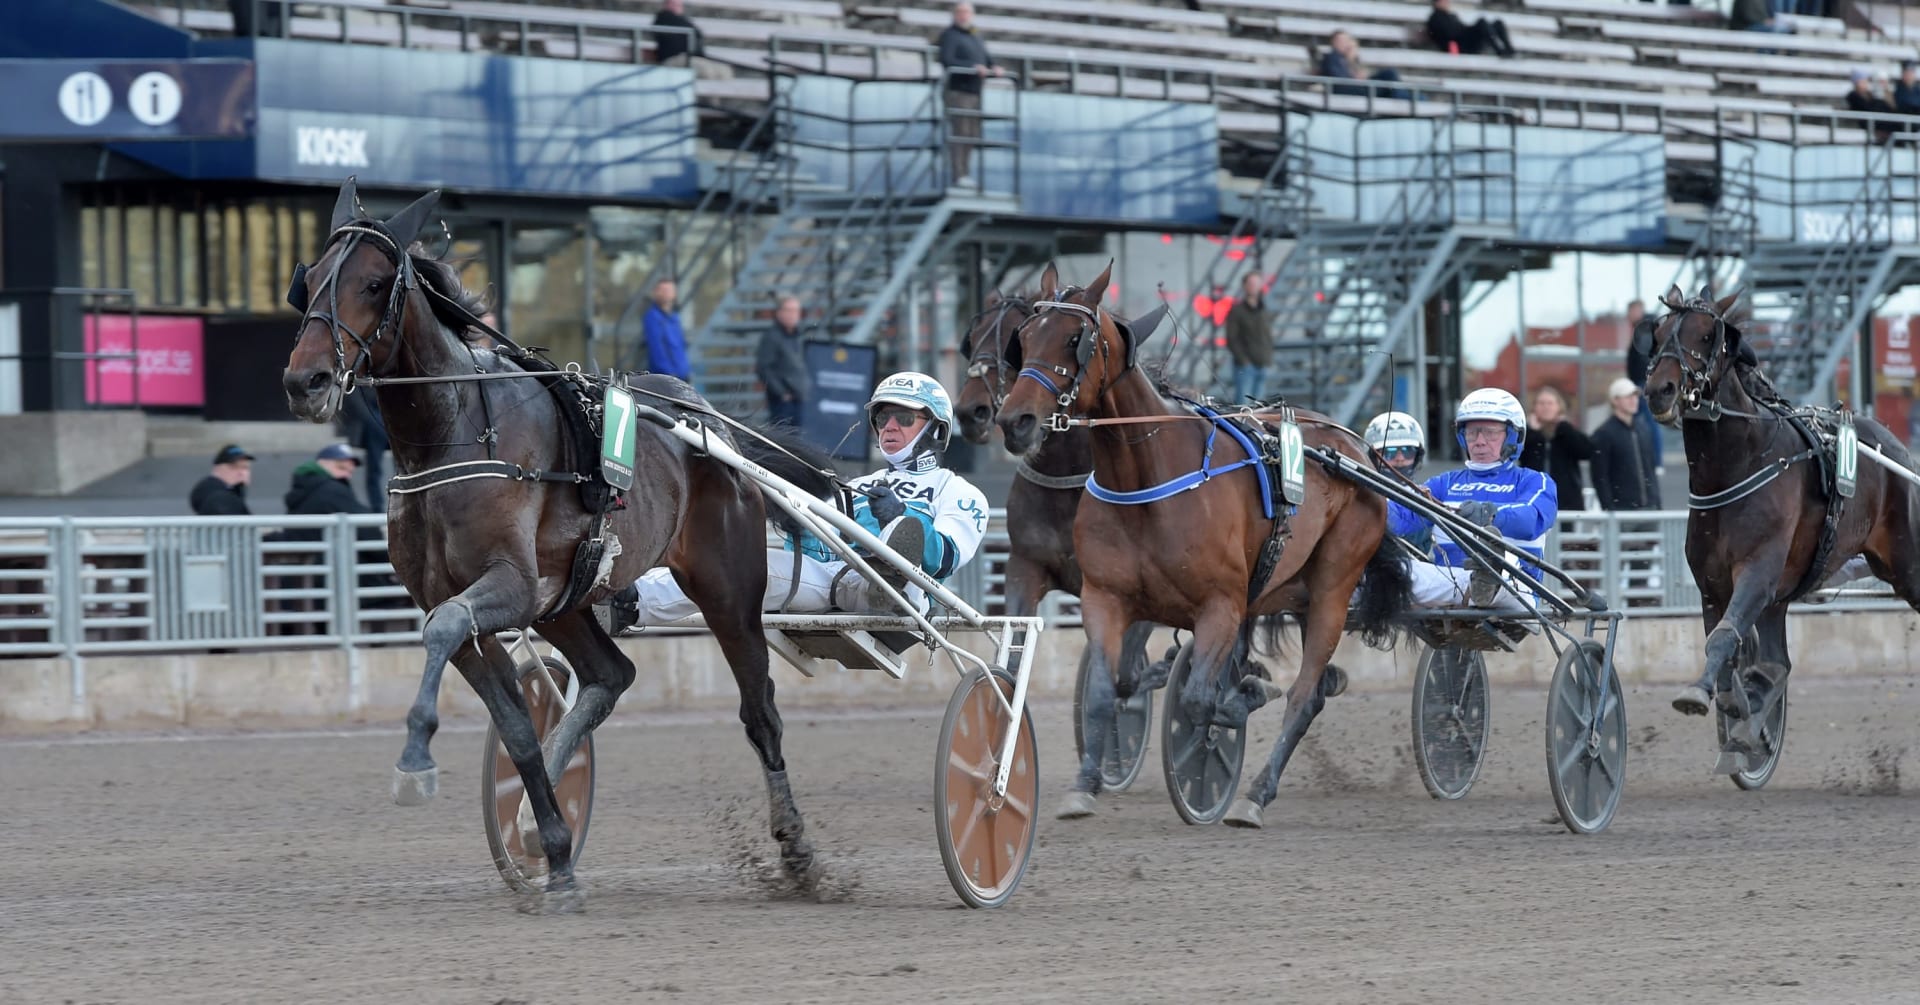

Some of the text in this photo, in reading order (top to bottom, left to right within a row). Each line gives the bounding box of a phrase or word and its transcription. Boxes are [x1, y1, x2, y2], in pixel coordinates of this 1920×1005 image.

[297, 127, 369, 167] KIOSK
[612, 390, 631, 458] 7
[918, 457, 936, 469] SVEA
[1281, 424, 1304, 484] 12
[1839, 426, 1857, 480] 10
[1450, 482, 1515, 493] USTOM
